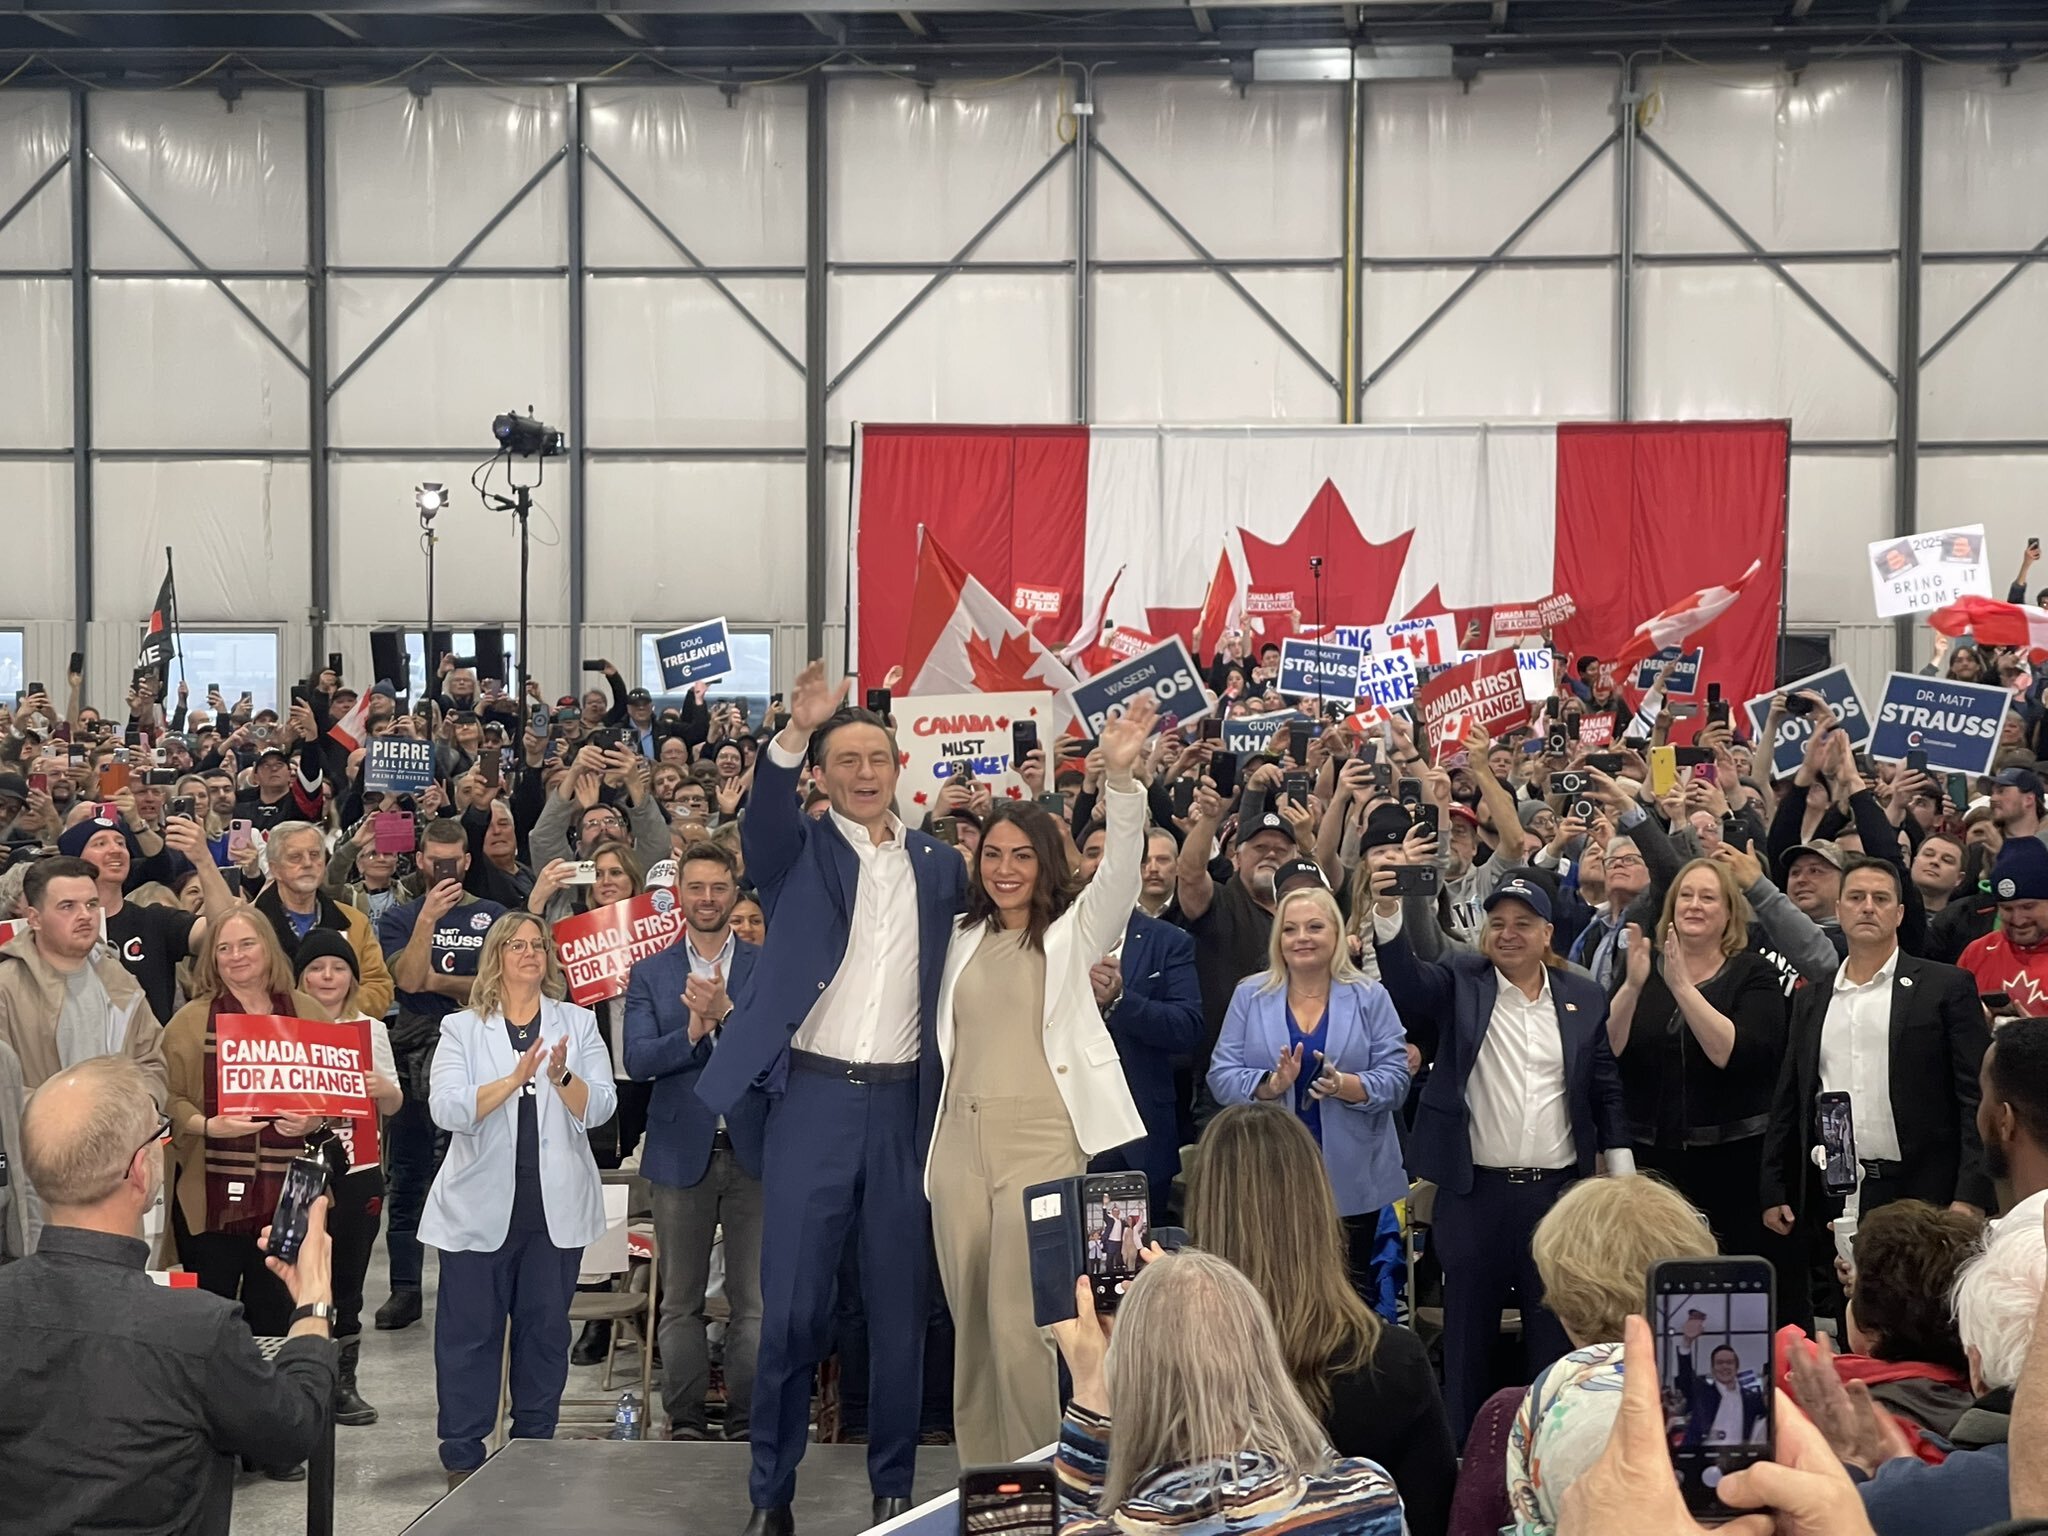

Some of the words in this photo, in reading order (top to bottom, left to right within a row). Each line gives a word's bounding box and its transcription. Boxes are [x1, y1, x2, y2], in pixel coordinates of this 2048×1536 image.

[1893, 575, 1942, 594] BRING
[1963, 568, 1976, 582] IT
[1538, 592, 1573, 614] CANADA
[1908, 588, 1961, 607] HOME
[1494, 610, 1524, 621] CANADA
[1542, 607, 1570, 626] FIRST
[1386, 618, 1435, 636] CANADA
[680, 636, 703, 649] DOUG
[662, 641, 725, 668] TRELEAVEN
[1319, 650, 1341, 660] MATT
[1284, 657, 1357, 678] STRAUSS
[1643, 658, 1697, 674] DERDER
[1104, 664, 1156, 696] WASEEM
[1425, 685, 1471, 723] CANADA
[1471, 668, 1518, 698] FIRST
[1916, 689, 1936, 702] DR.
[1939, 693, 1975, 708] MATT
[913, 714, 995, 736] CANADA
[1880, 702, 1998, 738] STRAUSS
[372, 740, 430, 760] PIERRE
[941, 740, 985, 757] MUST
[1229, 734, 1272, 752] KHA
[372, 759, 430, 771] POILIEVRE
[561, 927, 635, 963] CANADA
[633, 907, 682, 940] FIRST
[570, 958, 604, 985] FOR
[606, 954, 618, 974] A
[221, 1039, 309, 1064] CANADA
[310, 1043, 360, 1070] FIRST
[226, 1068, 265, 1090] FOR
[270, 1068, 285, 1090] A
[289, 1068, 363, 1095] CHANGE
